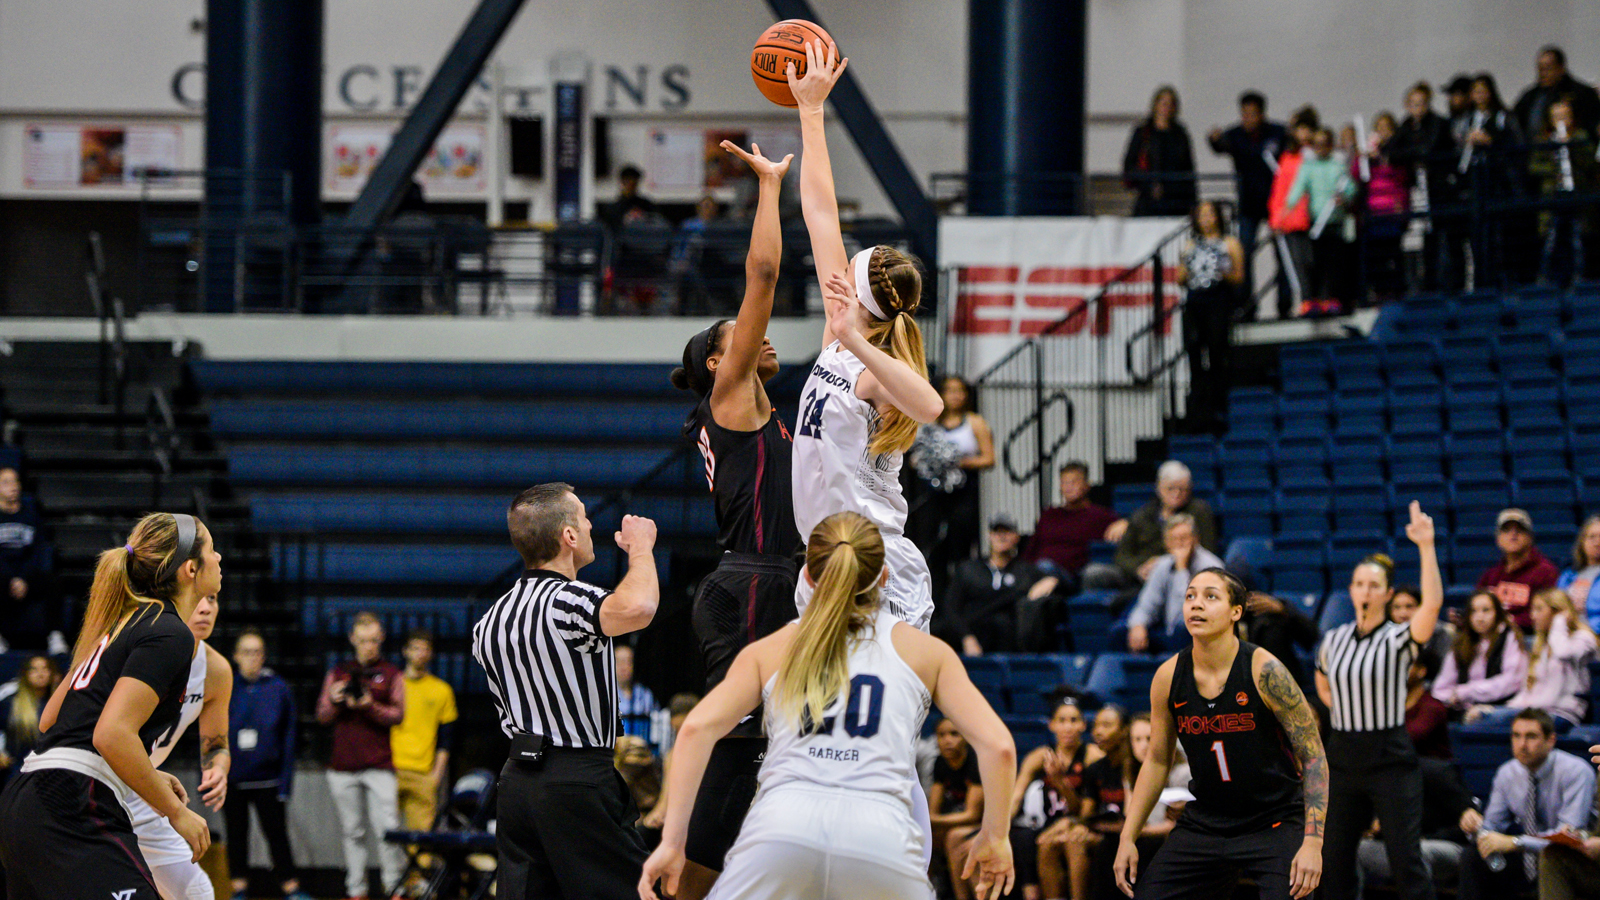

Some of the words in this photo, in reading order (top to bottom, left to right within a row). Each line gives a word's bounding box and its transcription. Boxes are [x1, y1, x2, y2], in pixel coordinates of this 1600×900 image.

[753, 52, 778, 74] ROCK
[1177, 712, 1256, 735] HOKIES
[808, 747, 860, 762] BARKER
[1210, 740, 1232, 782] 1
